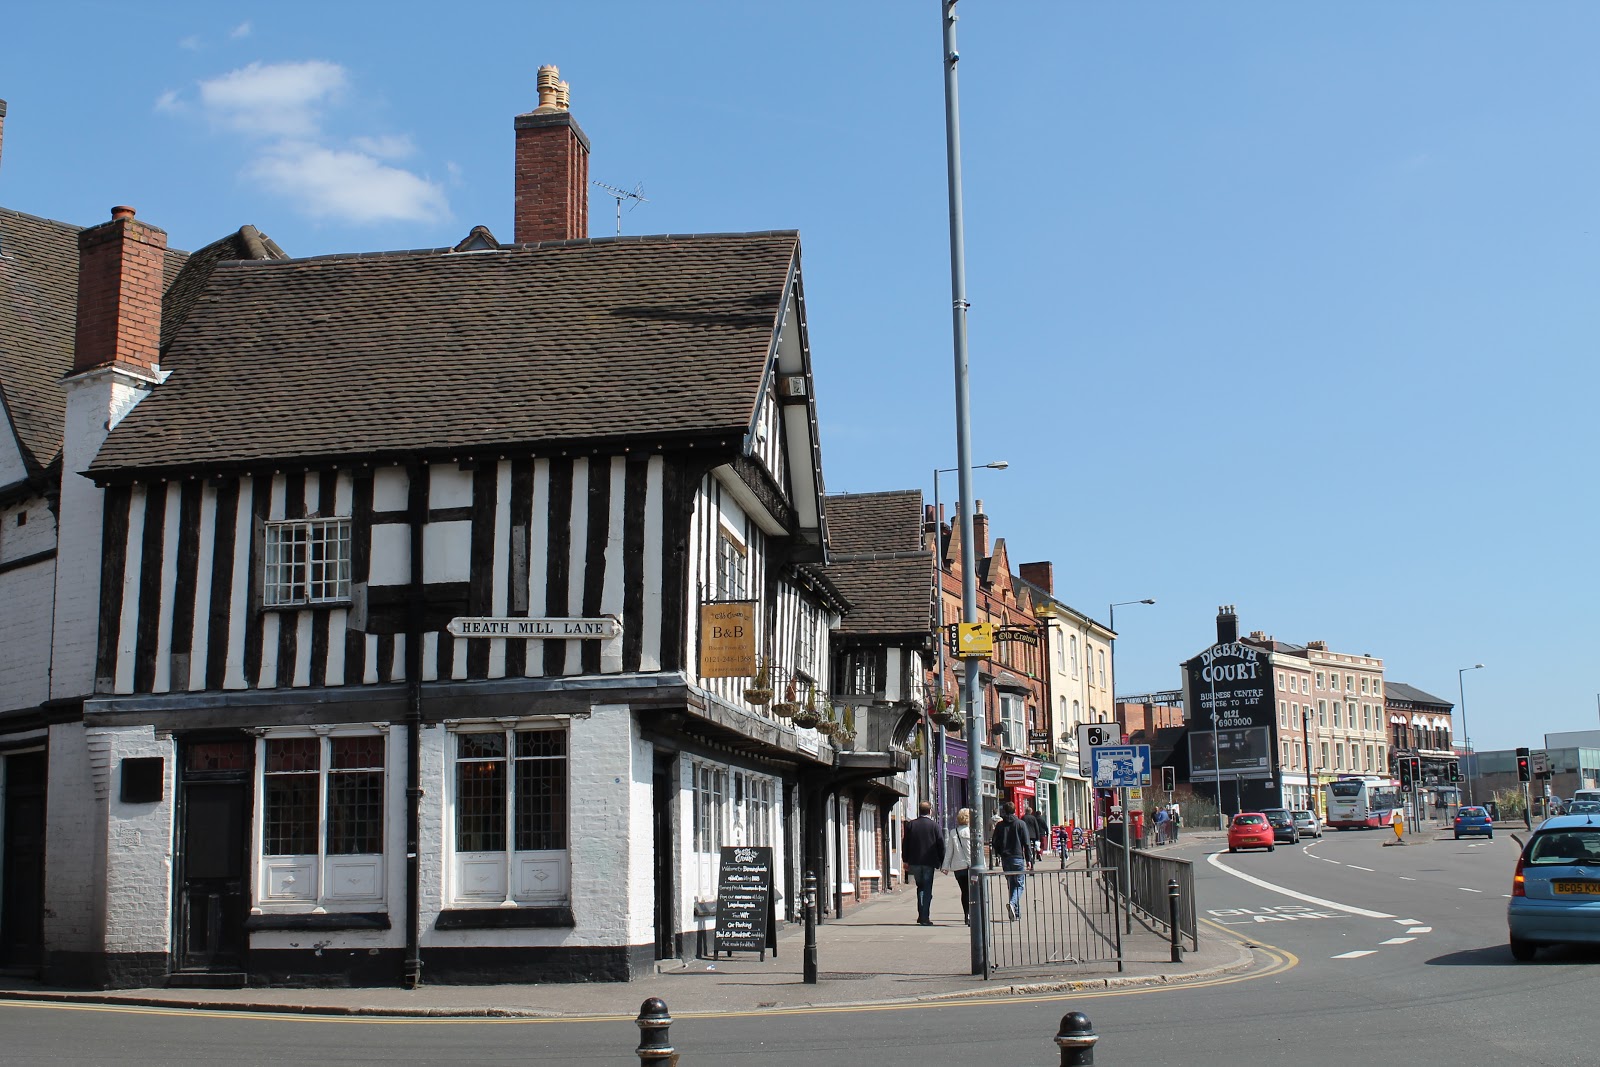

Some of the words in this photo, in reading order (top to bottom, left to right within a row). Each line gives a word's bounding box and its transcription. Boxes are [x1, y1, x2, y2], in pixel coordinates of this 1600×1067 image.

[462, 622, 510, 633] HEATH
[518, 622, 554, 634] MILL
[564, 622, 604, 634] LANE
[713, 625, 744, 639] B&B
[998, 632, 1012, 640] Old
[1013, 632, 1036, 644] Crown
[1200, 643, 1257, 666] DIGBETH
[1202, 661, 1260, 682] COURT
[1200, 691, 1231, 701] BUSNESS
[1233, 688, 1264, 697] CENTRE
[1201, 700, 1227, 708] OFFCES
[1245, 697, 1260, 705] LET
[1223, 709, 1240, 719] 0121
[1218, 718, 1233, 727] 690
[1233, 717, 1253, 726] 9000
[1558, 883, 1583, 892] BG05
[1206, 905, 1315, 917] BUS
[1211, 911, 1350, 925] LANE
